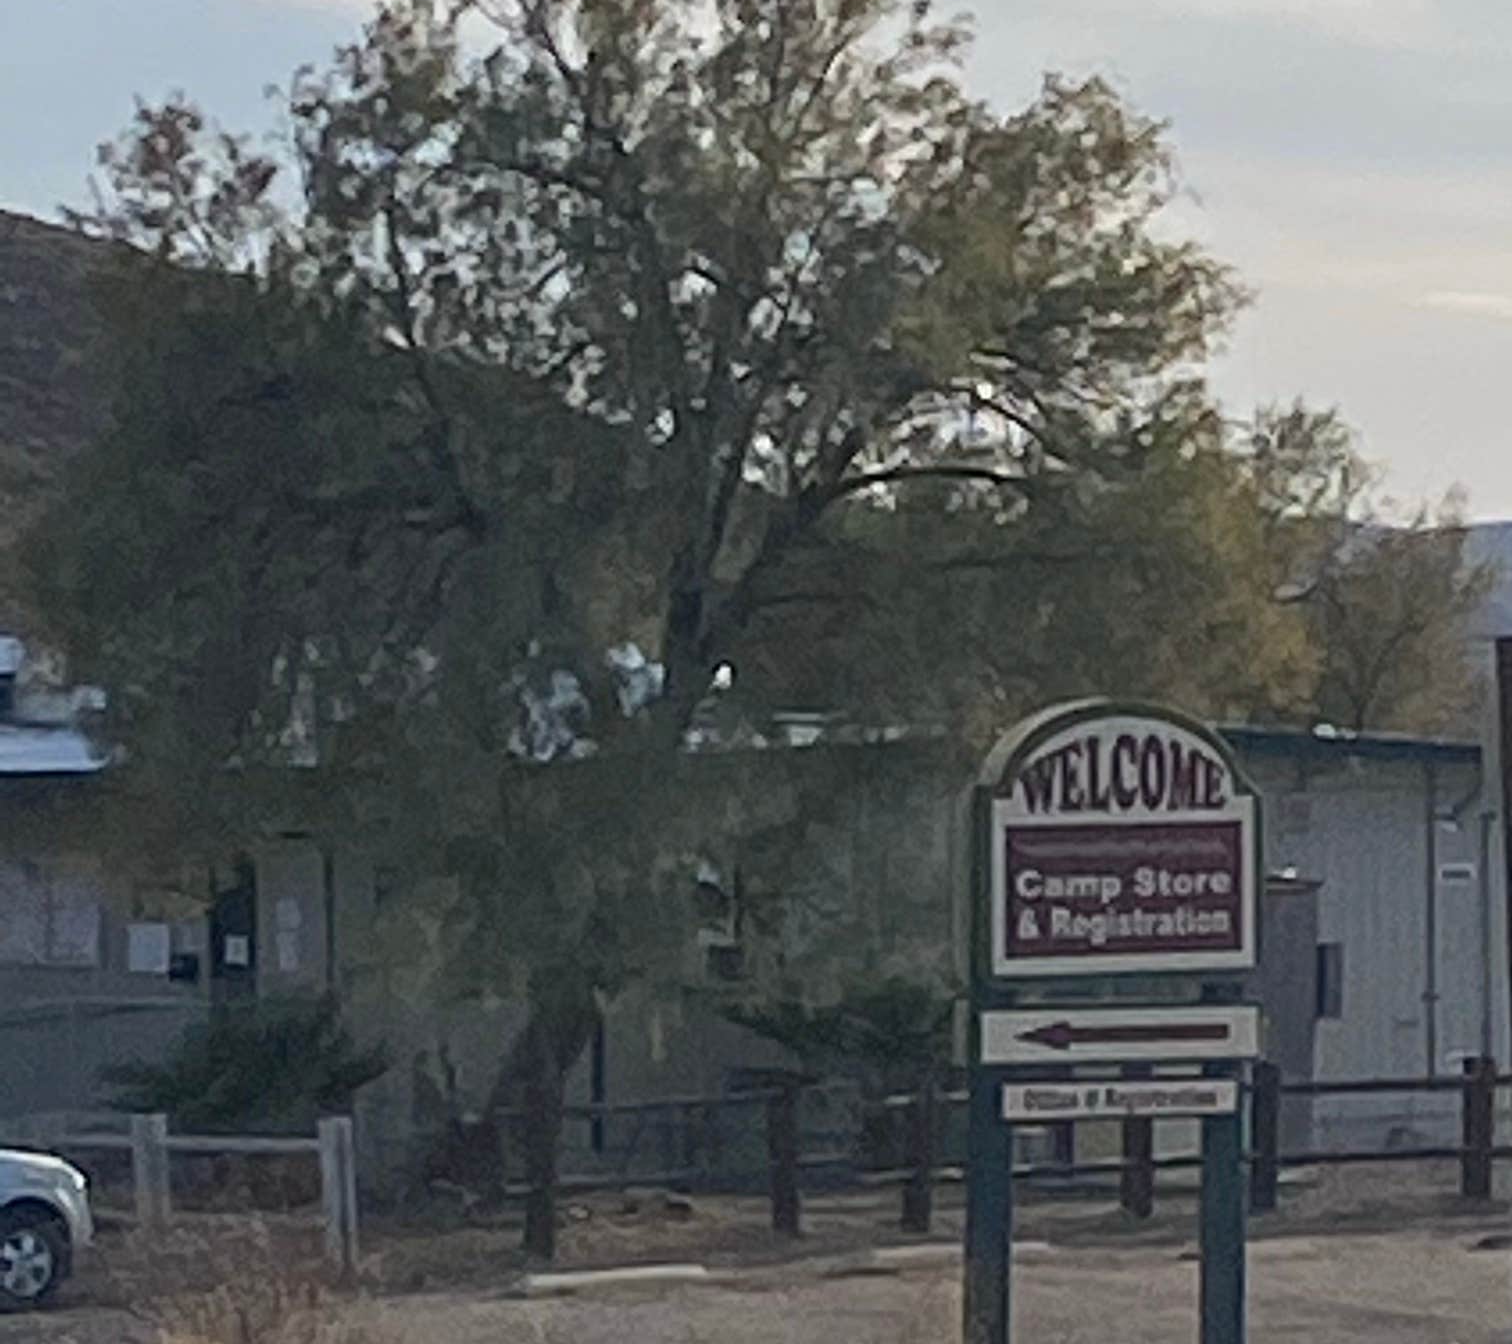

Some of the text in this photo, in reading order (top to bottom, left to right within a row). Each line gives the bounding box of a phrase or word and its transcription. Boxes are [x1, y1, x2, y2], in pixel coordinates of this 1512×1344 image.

[1019, 733, 1226, 814] WELCOME
[1015, 866, 1231, 903] Camp Store
[1018, 906, 1230, 946] & Registration
